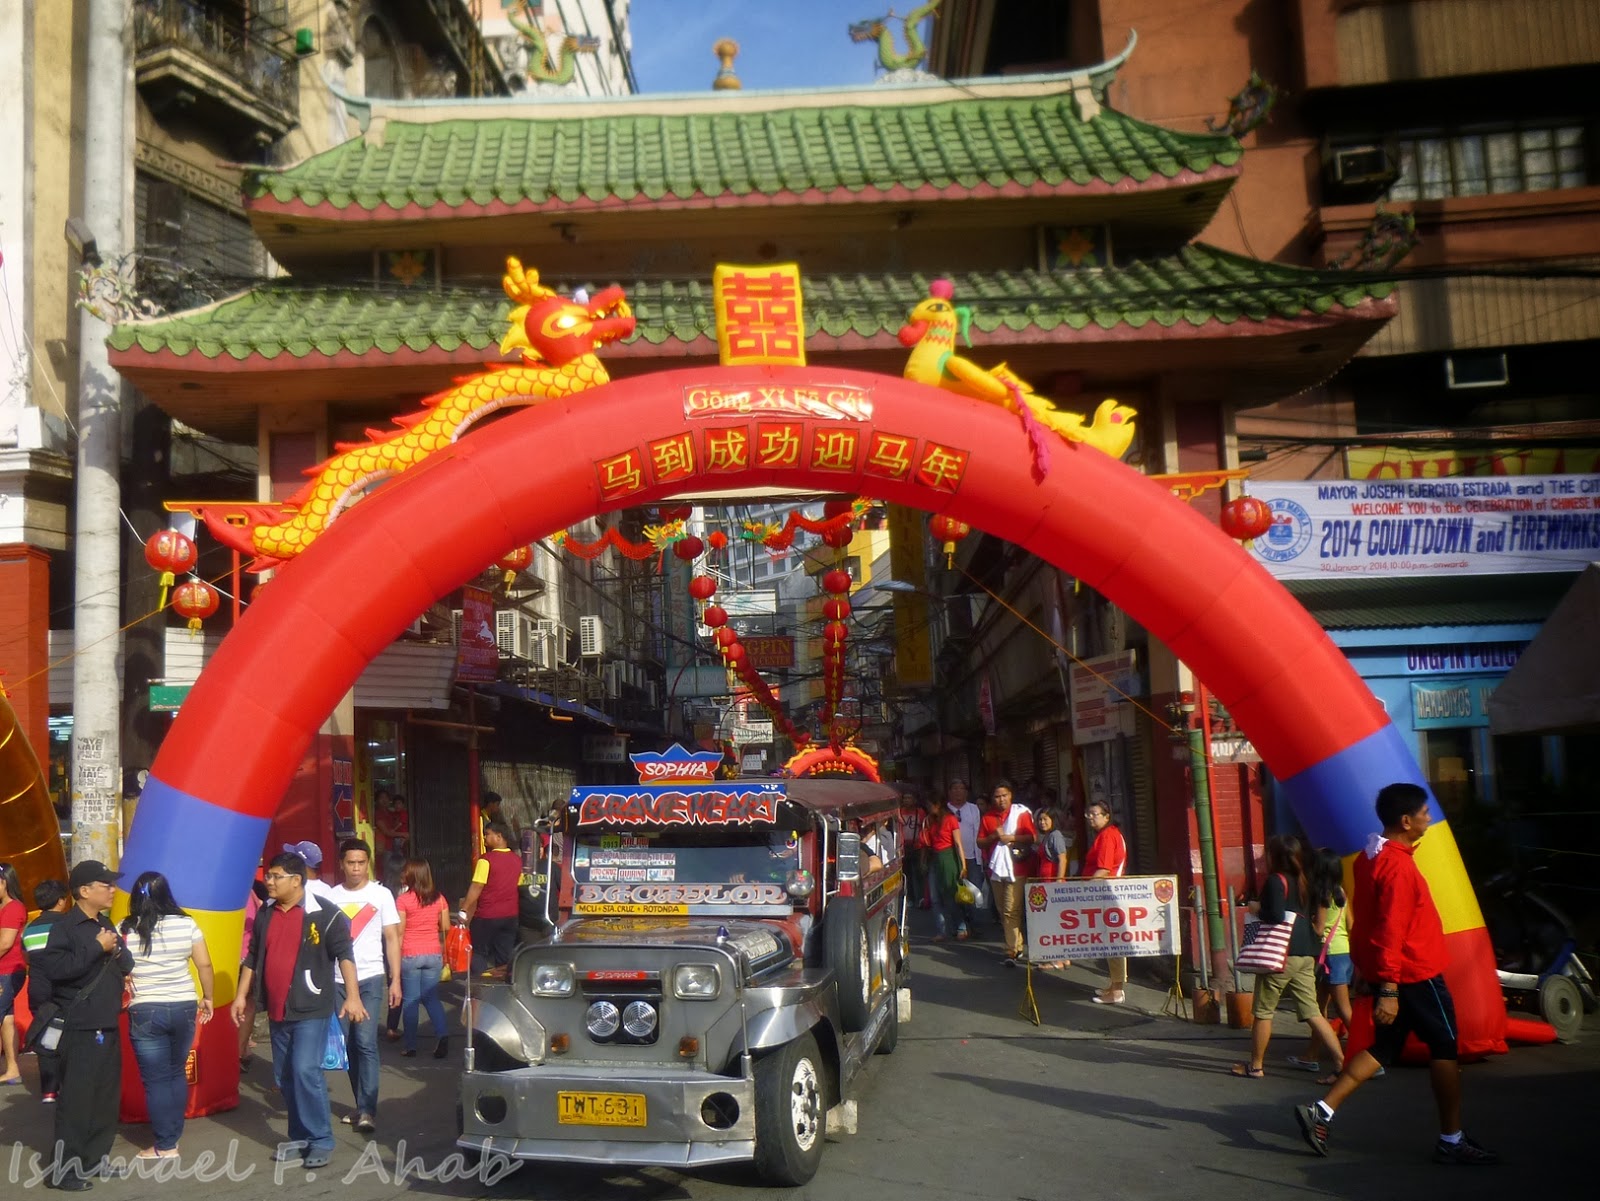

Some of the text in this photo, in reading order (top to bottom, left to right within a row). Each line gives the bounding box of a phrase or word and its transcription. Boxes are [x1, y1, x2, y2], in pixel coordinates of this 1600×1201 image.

[601, 427, 962, 492] 马到成功迎马年
[1318, 486, 1357, 500] MAYOR
[1361, 485, 1405, 500] JOSEPH
[1409, 483, 1460, 498] EJERCITO
[1463, 481, 1511, 496] ESTRADA
[1517, 482, 1544, 495] and
[1549, 480, 1575, 493] THE
[1352, 502, 1403, 515] WELCOME
[1408, 502, 1427, 514] YOU
[1430, 501, 1441, 513] to
[1446, 501, 1462, 513] the
[1465, 498, 1534, 513] CELEBRATION
[1536, 499, 1547, 510] of
[1551, 497, 1591, 510] CHINESE
[1320, 520, 1363, 558] 2014
[1367, 517, 1474, 557] COUNTDOWN
[1476, 521, 1507, 554] and
[1320, 563, 1331, 572] 30
[645, 761, 707, 777] SOPHIA
[1054, 884, 1148, 895] MEISIC POLICE STATION
[1076, 895, 1094, 903] POLICE
[1095, 894, 1127, 902] COMMUNITY
[643, 905, 680, 913] ROTONDA
[1059, 906, 1149, 930] STOP
[1039, 929, 1166, 947] CHECK POINT
